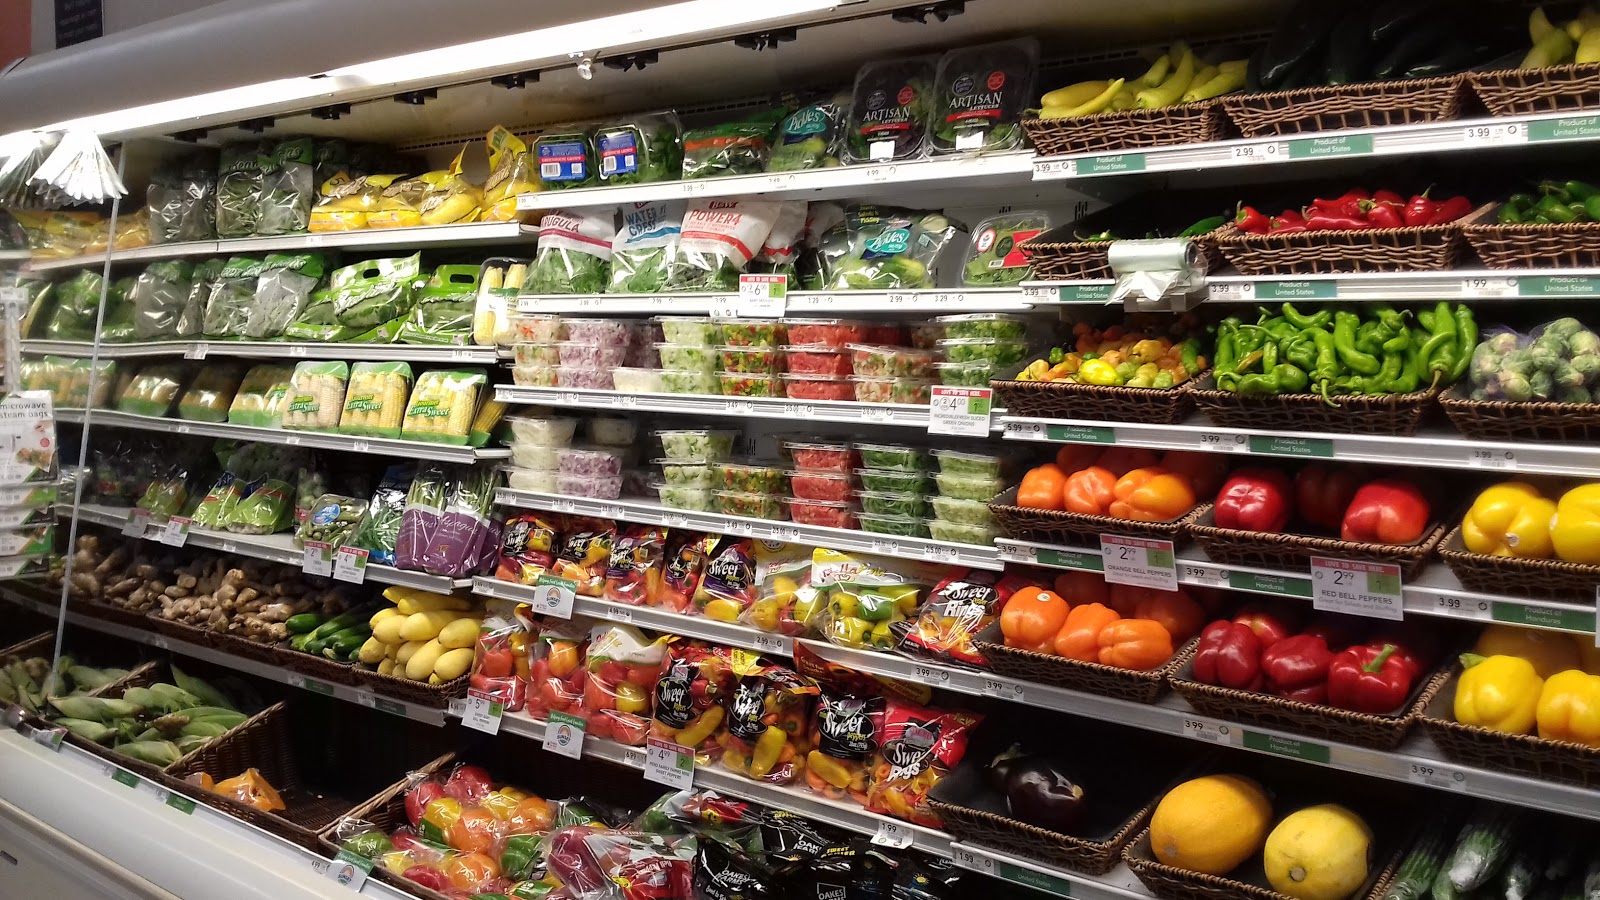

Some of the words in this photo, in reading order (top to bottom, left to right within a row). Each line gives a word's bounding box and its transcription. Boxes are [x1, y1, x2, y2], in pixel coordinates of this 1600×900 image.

[949, 92, 1004, 109] ARTISAN
[863, 107, 912, 122] ARTISAN
[1558, 119, 1586, 127] Product
[1588, 117, 1597, 125] of
[1468, 128, 1490, 138] 3.99
[1314, 138, 1337, 146] Product
[1236, 147, 1254, 157] 2.99
[1035, 163, 1050, 172] 3.99
[625, 207, 657, 225] WATER
[689, 209, 743, 226] POWER4
[1212, 284, 1230, 293] 3.99
[1465, 279, 1487, 288] 1.99
[1024, 287, 1039, 296] 3.99
[935, 294, 947, 302] 3.29
[361, 402, 383, 412] Sweet
[407, 405, 425, 417] Extra
[424, 407, 450, 419] Sweet
[1007, 423, 1022, 432] 5.99
[1201, 434, 1220, 443] 3.99
[1474, 450, 1491, 459] 3.99
[1001, 545, 1017, 554] 3.99
[1058, 558, 1083, 566] Honduras
[1325, 560, 1340, 568] LOVE
[1352, 563, 1366, 571] SAVE
[709, 560, 738, 576] Sweet
[1107, 564, 1132, 573] ORANGE
[1132, 567, 1146, 575] BELL
[1146, 569, 1172, 578] PEPPERS
[1186, 567, 1205, 577] 3.99
[1254, 575, 1277, 583] Product
[1255, 582, 1285, 591] Honduras
[951, 586, 990, 600] Sweet
[1321, 589, 1337, 598] RED
[1338, 591, 1356, 601] BELL
[1358, 594, 1393, 605] PEPPERS
[1439, 597, 1460, 608] 3.99
[1524, 606, 1553, 615] Product
[1525, 614, 1562, 625] Honduras
[756, 636, 768, 645] 2.99
[916, 667, 930, 677] 3.99
[987, 681, 1002, 690] 3.99
[661, 680, 686, 704] Sweet
[824, 711, 864, 738] Sweet
[1185, 720, 1203, 730] 3.99
[1269, 743, 1300, 754] Honduras
[1411, 764, 1434, 776] 3.99
[881, 822, 897, 833] 1.99
[959, 852, 974, 863] 1.99
[721, 868, 749, 882] OAKES
[818, 889, 844, 899] OAKES
